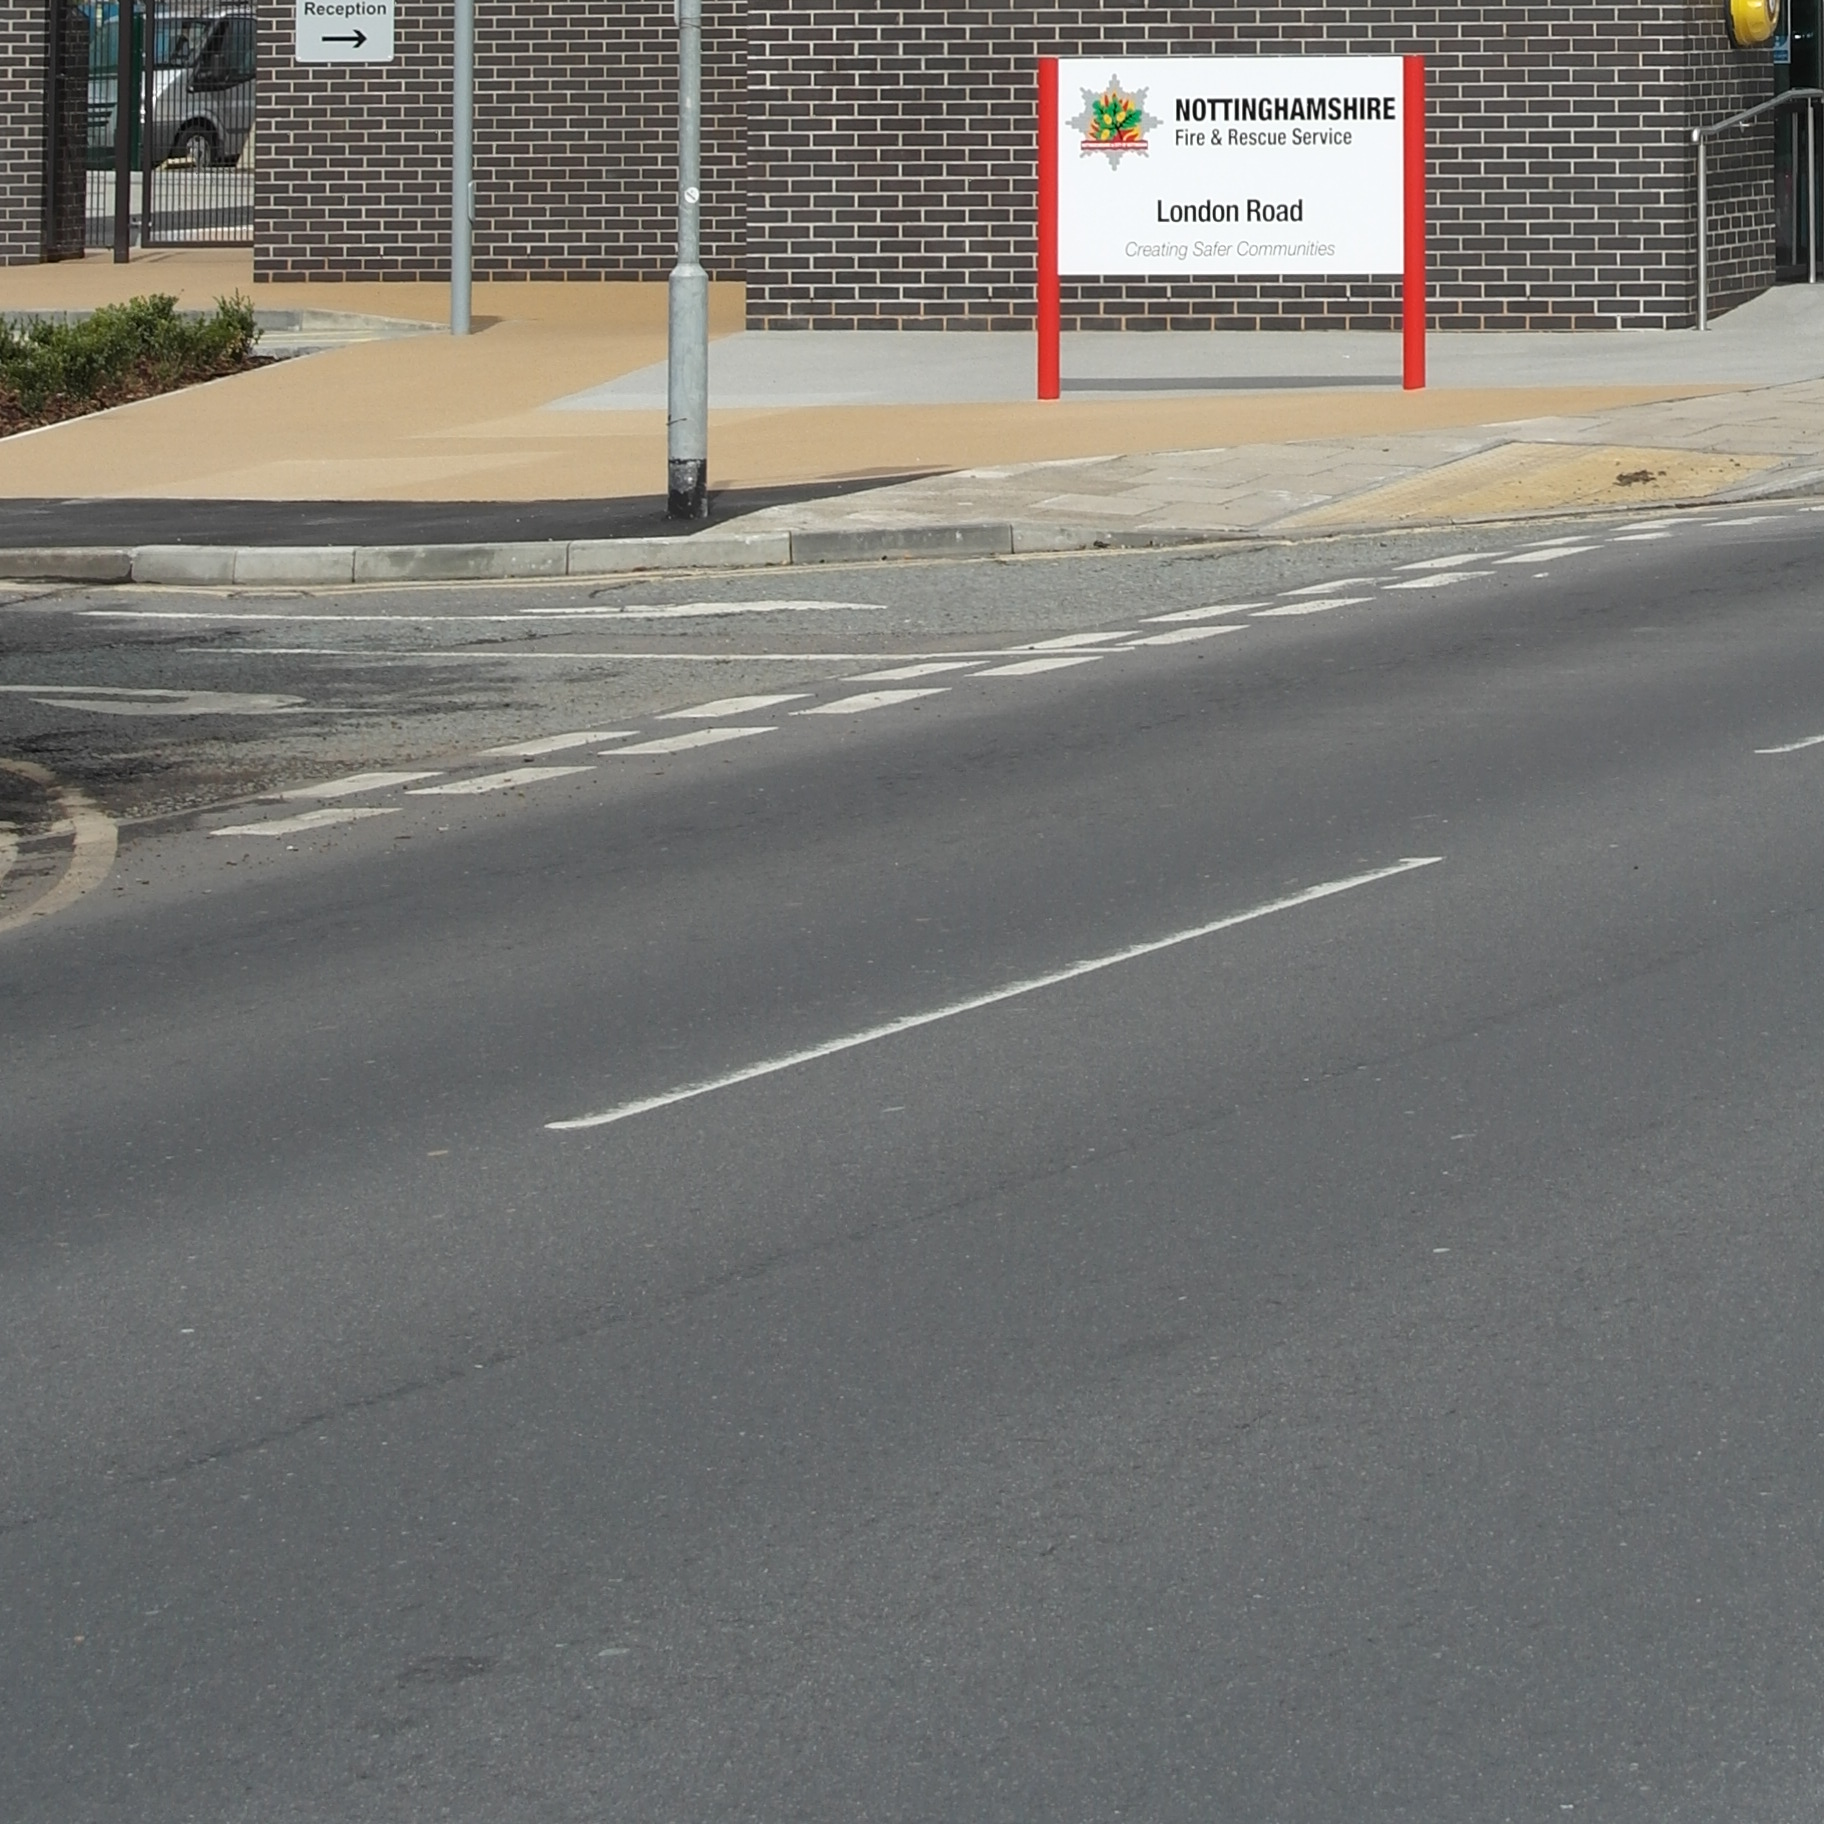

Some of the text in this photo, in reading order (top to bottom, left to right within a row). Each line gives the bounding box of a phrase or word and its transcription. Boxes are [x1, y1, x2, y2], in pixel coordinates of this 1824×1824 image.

[304, 1, 387, 18] Reception
[1175, 96, 1396, 122] NOTTINGHAMSHIRE
[1175, 127, 1352, 146] Fire & Rescue Service
[1157, 199, 1304, 223] London Road
[1124, 240, 1336, 261] Creating Safer Communities
